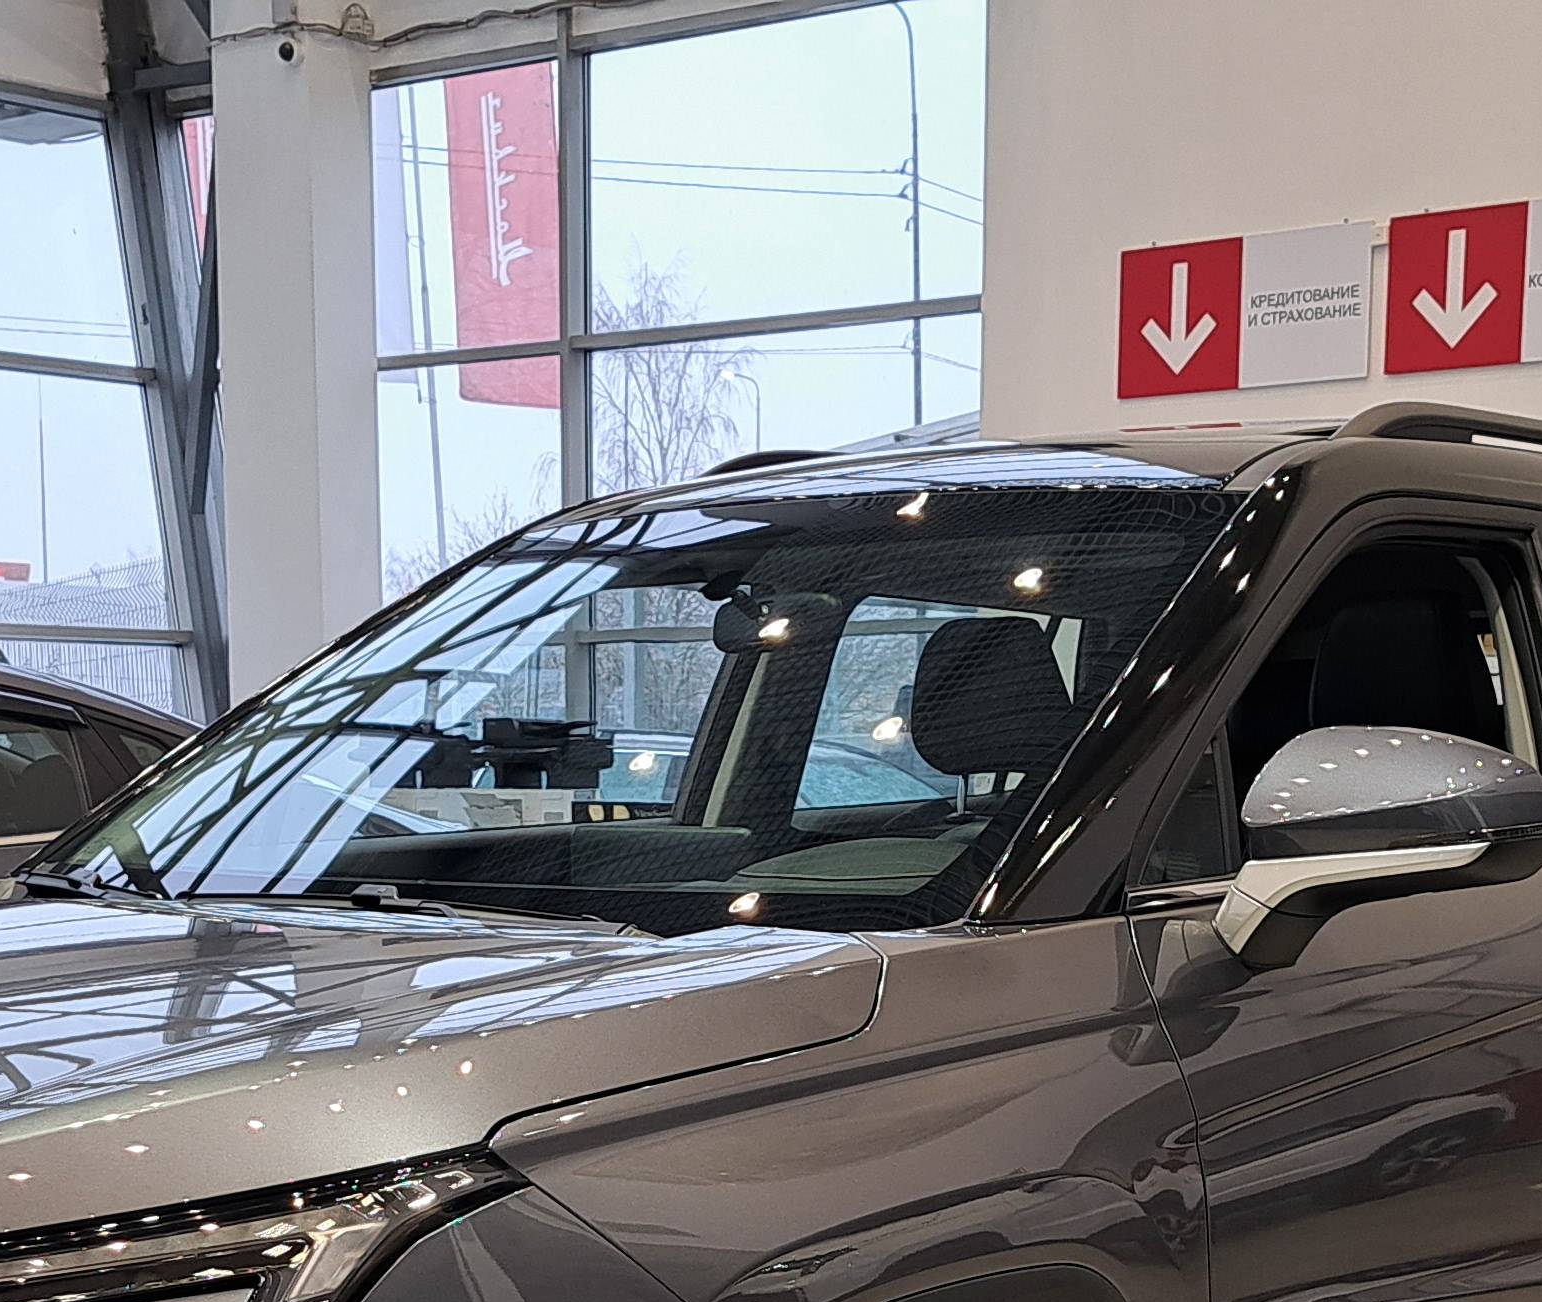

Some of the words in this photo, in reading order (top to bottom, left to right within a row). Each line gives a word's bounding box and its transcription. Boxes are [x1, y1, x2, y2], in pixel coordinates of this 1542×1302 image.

[1249, 283, 1360, 309] КРЕДИТОВАНИЕ
[1247, 313, 1258, 328] И
[1260, 302, 1362, 326] СТРАХОВАНИЕ
